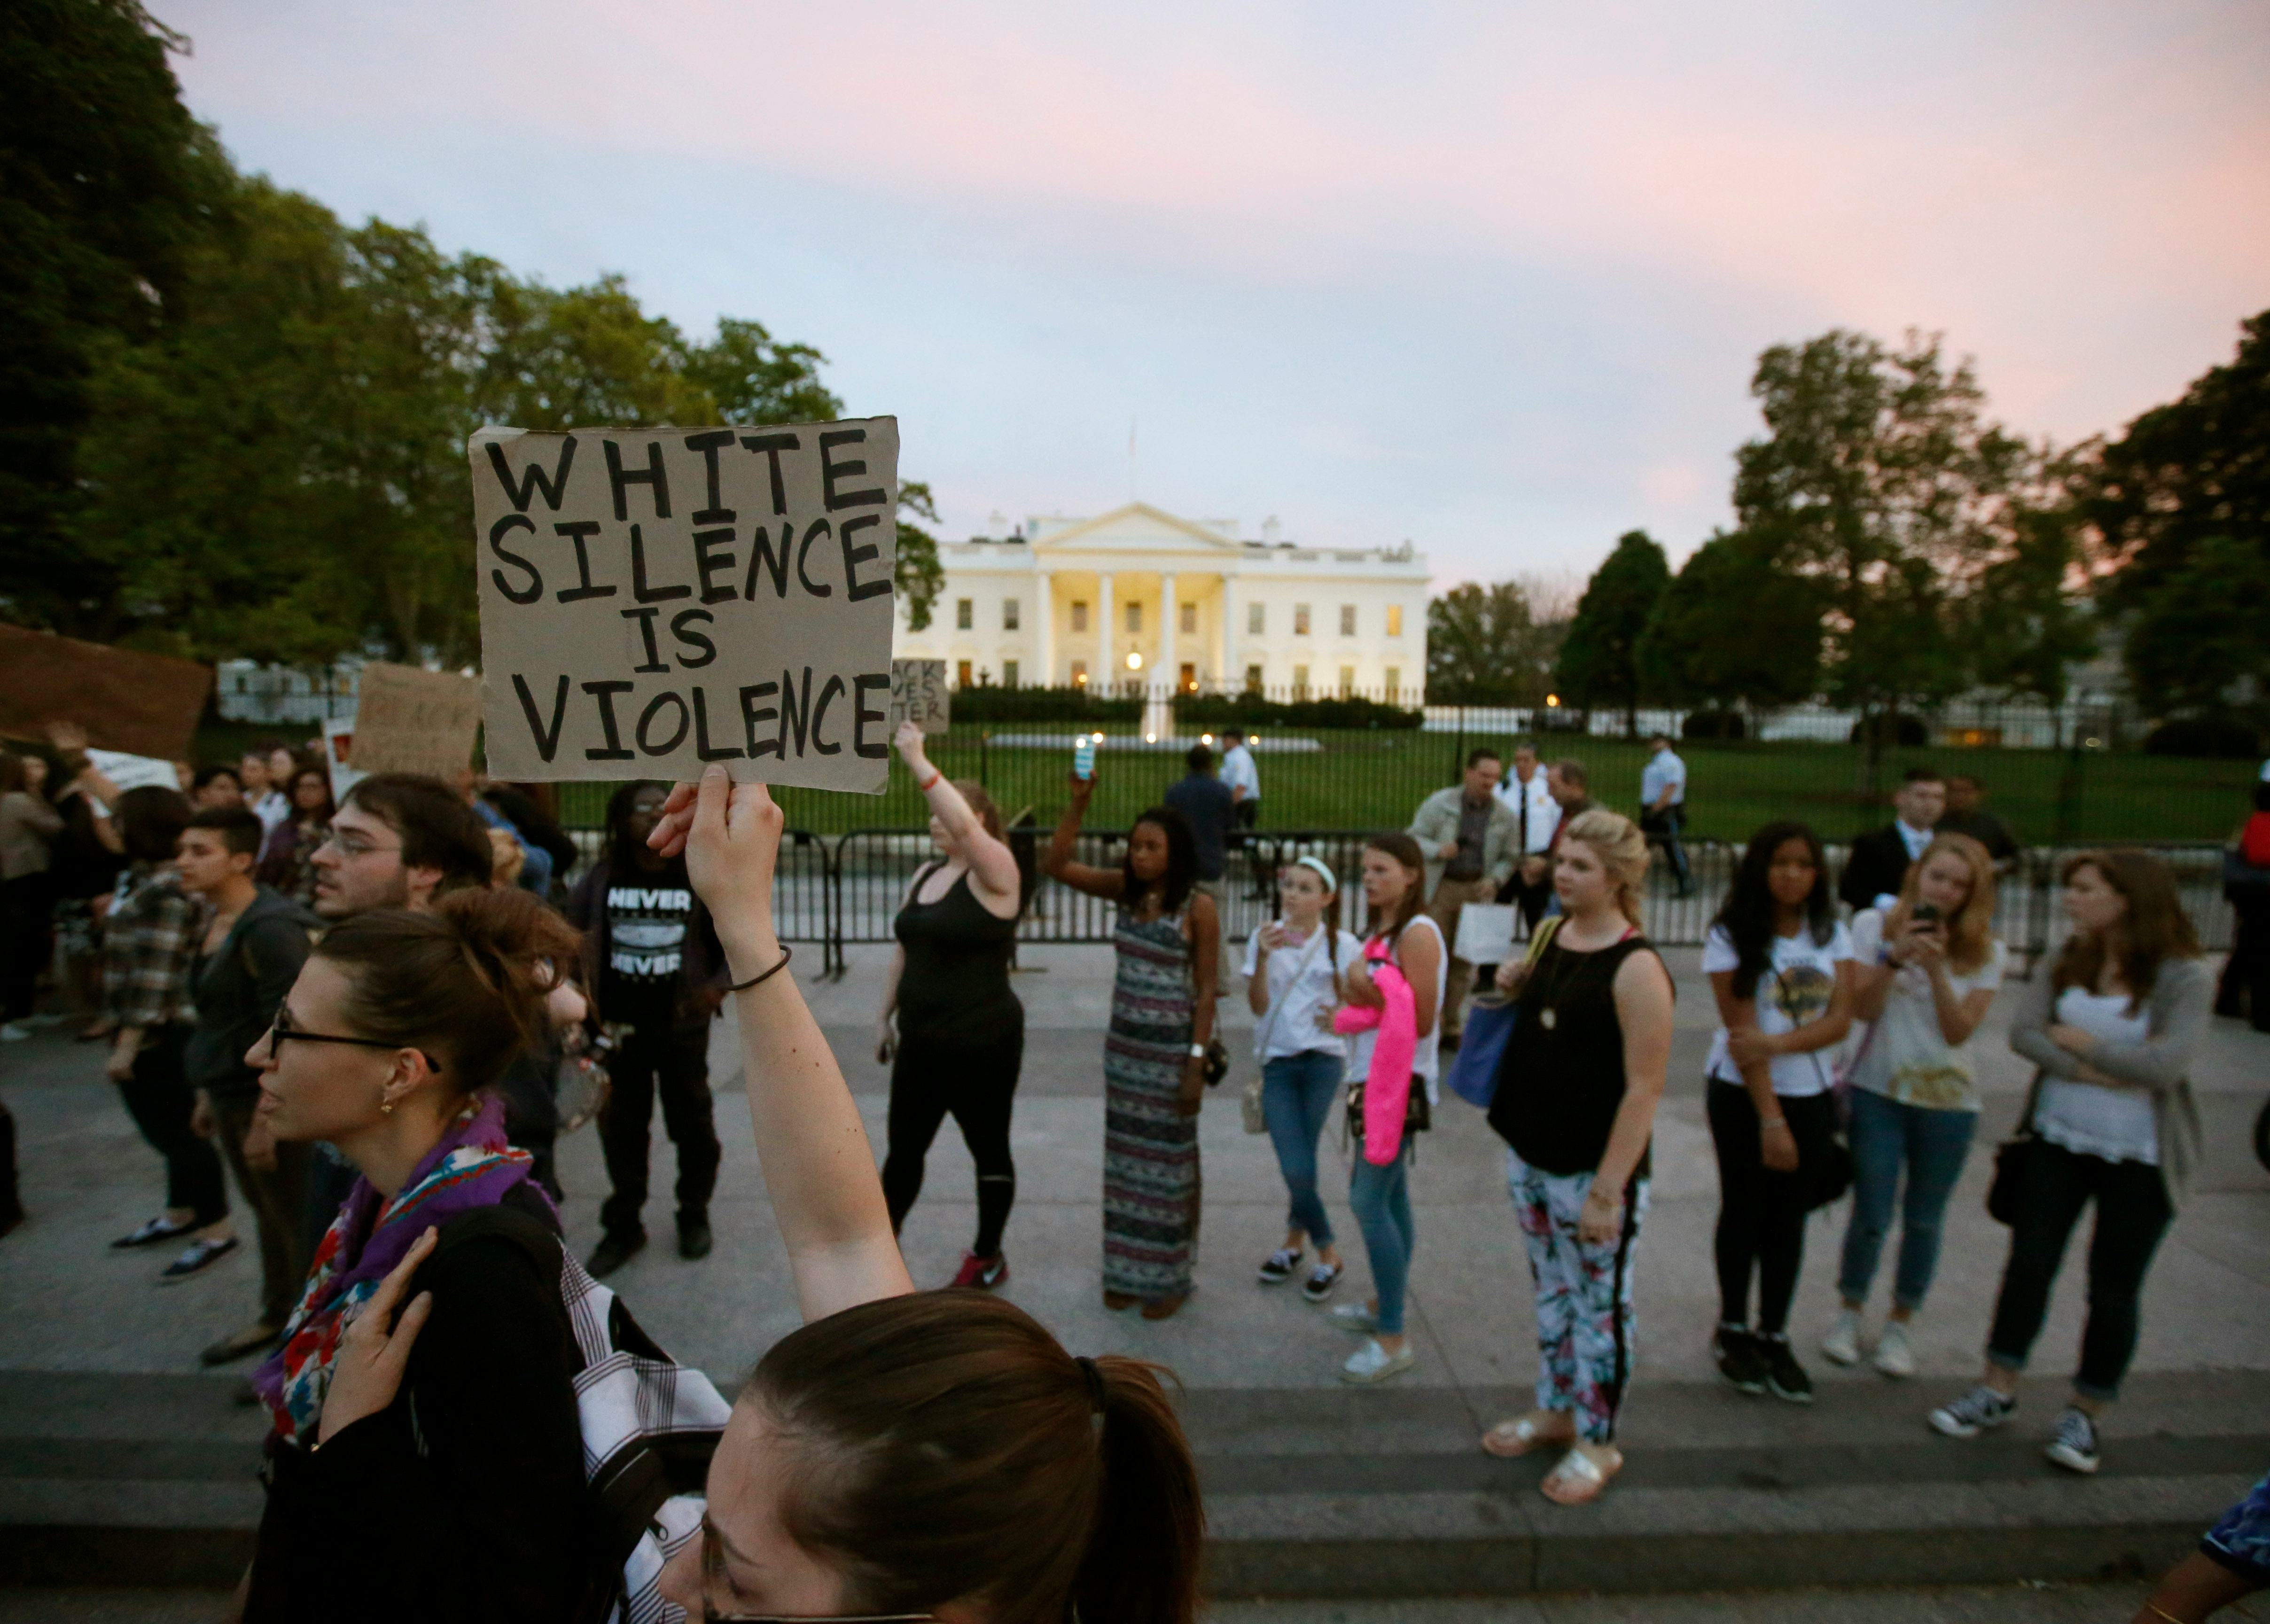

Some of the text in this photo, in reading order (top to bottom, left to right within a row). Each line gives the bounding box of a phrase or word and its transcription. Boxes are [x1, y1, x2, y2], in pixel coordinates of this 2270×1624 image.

[484, 429, 887, 525] WHITE
[489, 514, 892, 604] SILENCE
[620, 607, 717, 673] IS
[891, 679, 937, 701] VES
[892, 661, 940, 682] ACK
[511, 666, 891, 763] VIOLENCE
[890, 701, 944, 723] TER
[607, 887, 692, 912] NEVER
